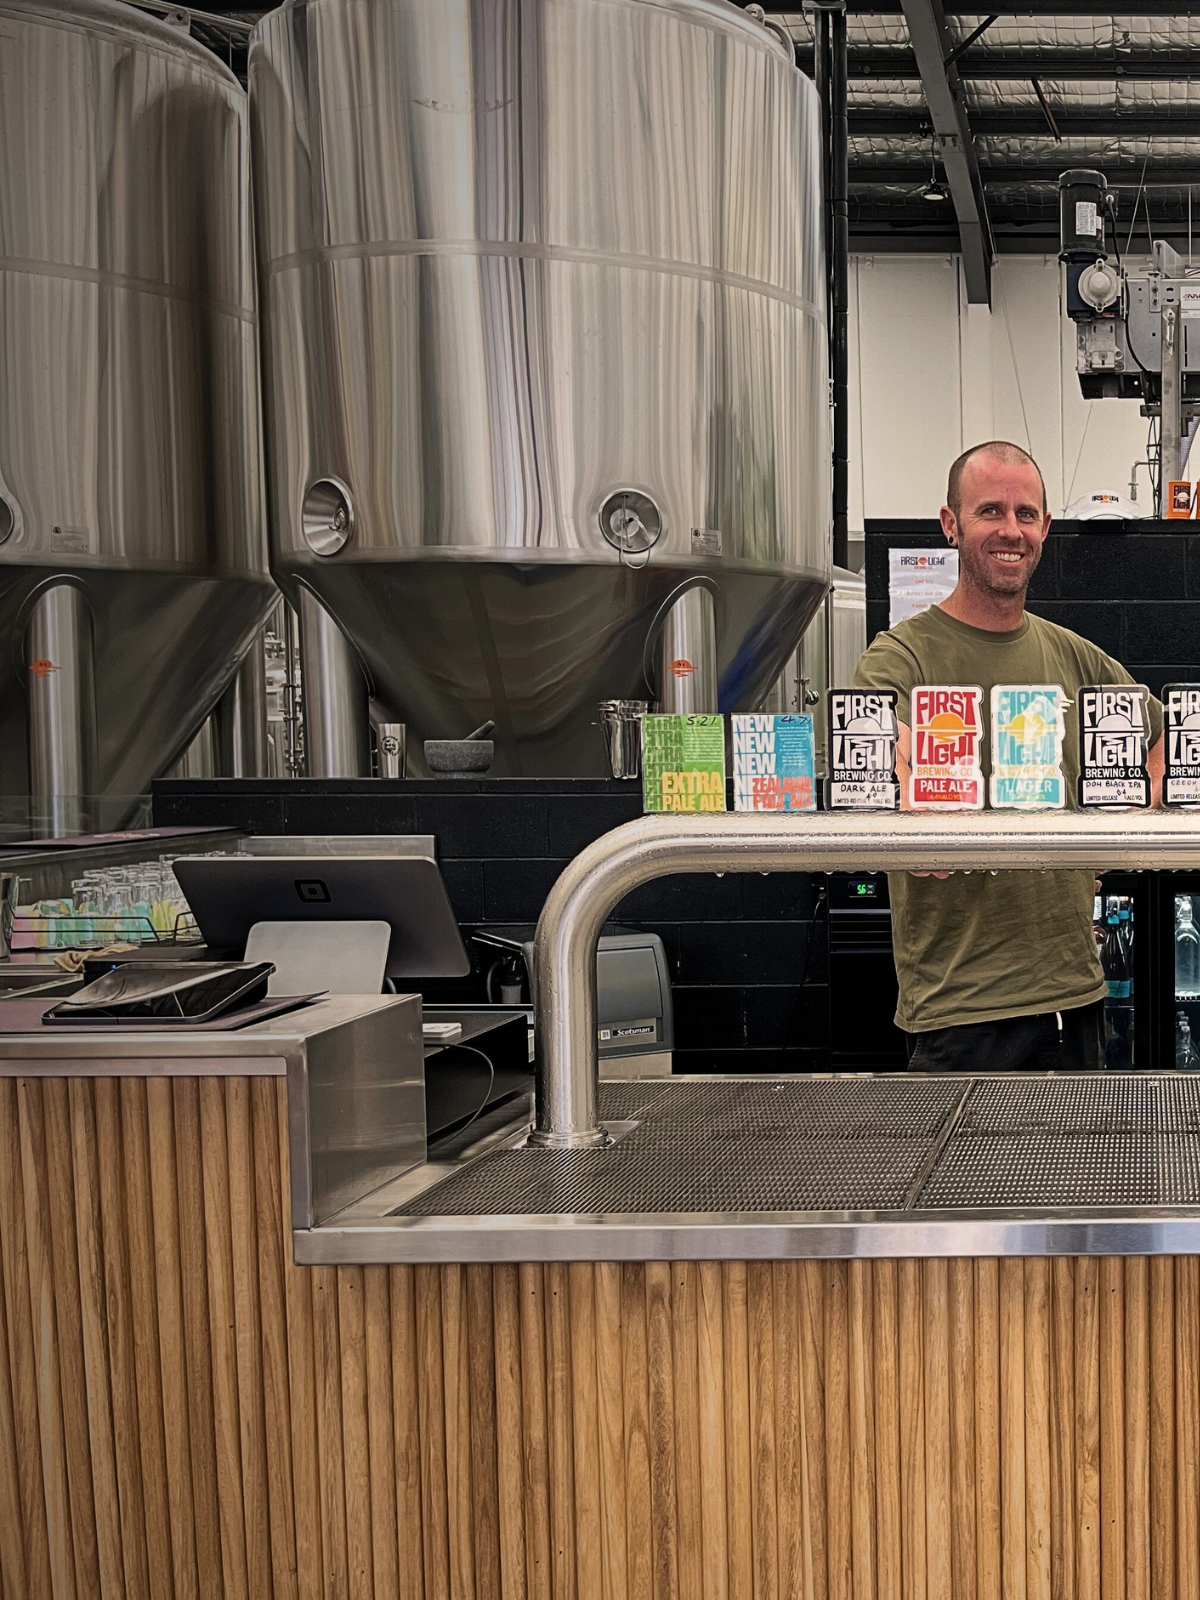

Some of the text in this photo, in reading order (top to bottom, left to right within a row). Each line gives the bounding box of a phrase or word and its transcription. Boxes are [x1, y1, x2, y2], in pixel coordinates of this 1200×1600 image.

[900, 556, 946, 566] FIRST LIGHT
[832, 694, 893, 729] FIRST
[916, 691, 976, 725] FIRST
[1083, 692, 1144, 727] FIRST
[732, 715, 775, 732] NEW
[734, 732, 776, 753] NEW
[916, 731, 977, 765] LIGHT
[1084, 732, 1145, 768] LIGHT
[833, 735, 894, 769] LIGHT
[735, 753, 777, 775] NEW
[917, 766, 957, 776] BREWING
[1085, 767, 1144, 778] BREWING CO.
[661, 771, 724, 790] EXTRA
[833, 770, 893, 781] BREWING CO.
[752, 776, 813, 794] ZEALAND
[840, 784, 887, 793] DARK ALE
[919, 780, 973, 793] PALE ALE
[1003, 780, 1053, 793] LAGER
[1105, 780, 1126, 788] BLACK
[1128, 781, 1142, 789] IPA
[662, 794, 695, 811] PALE
[699, 794, 724, 811] ALE
[753, 792, 813, 810] PALE ALE
[617, 1027, 651, 1037] Scotsman
